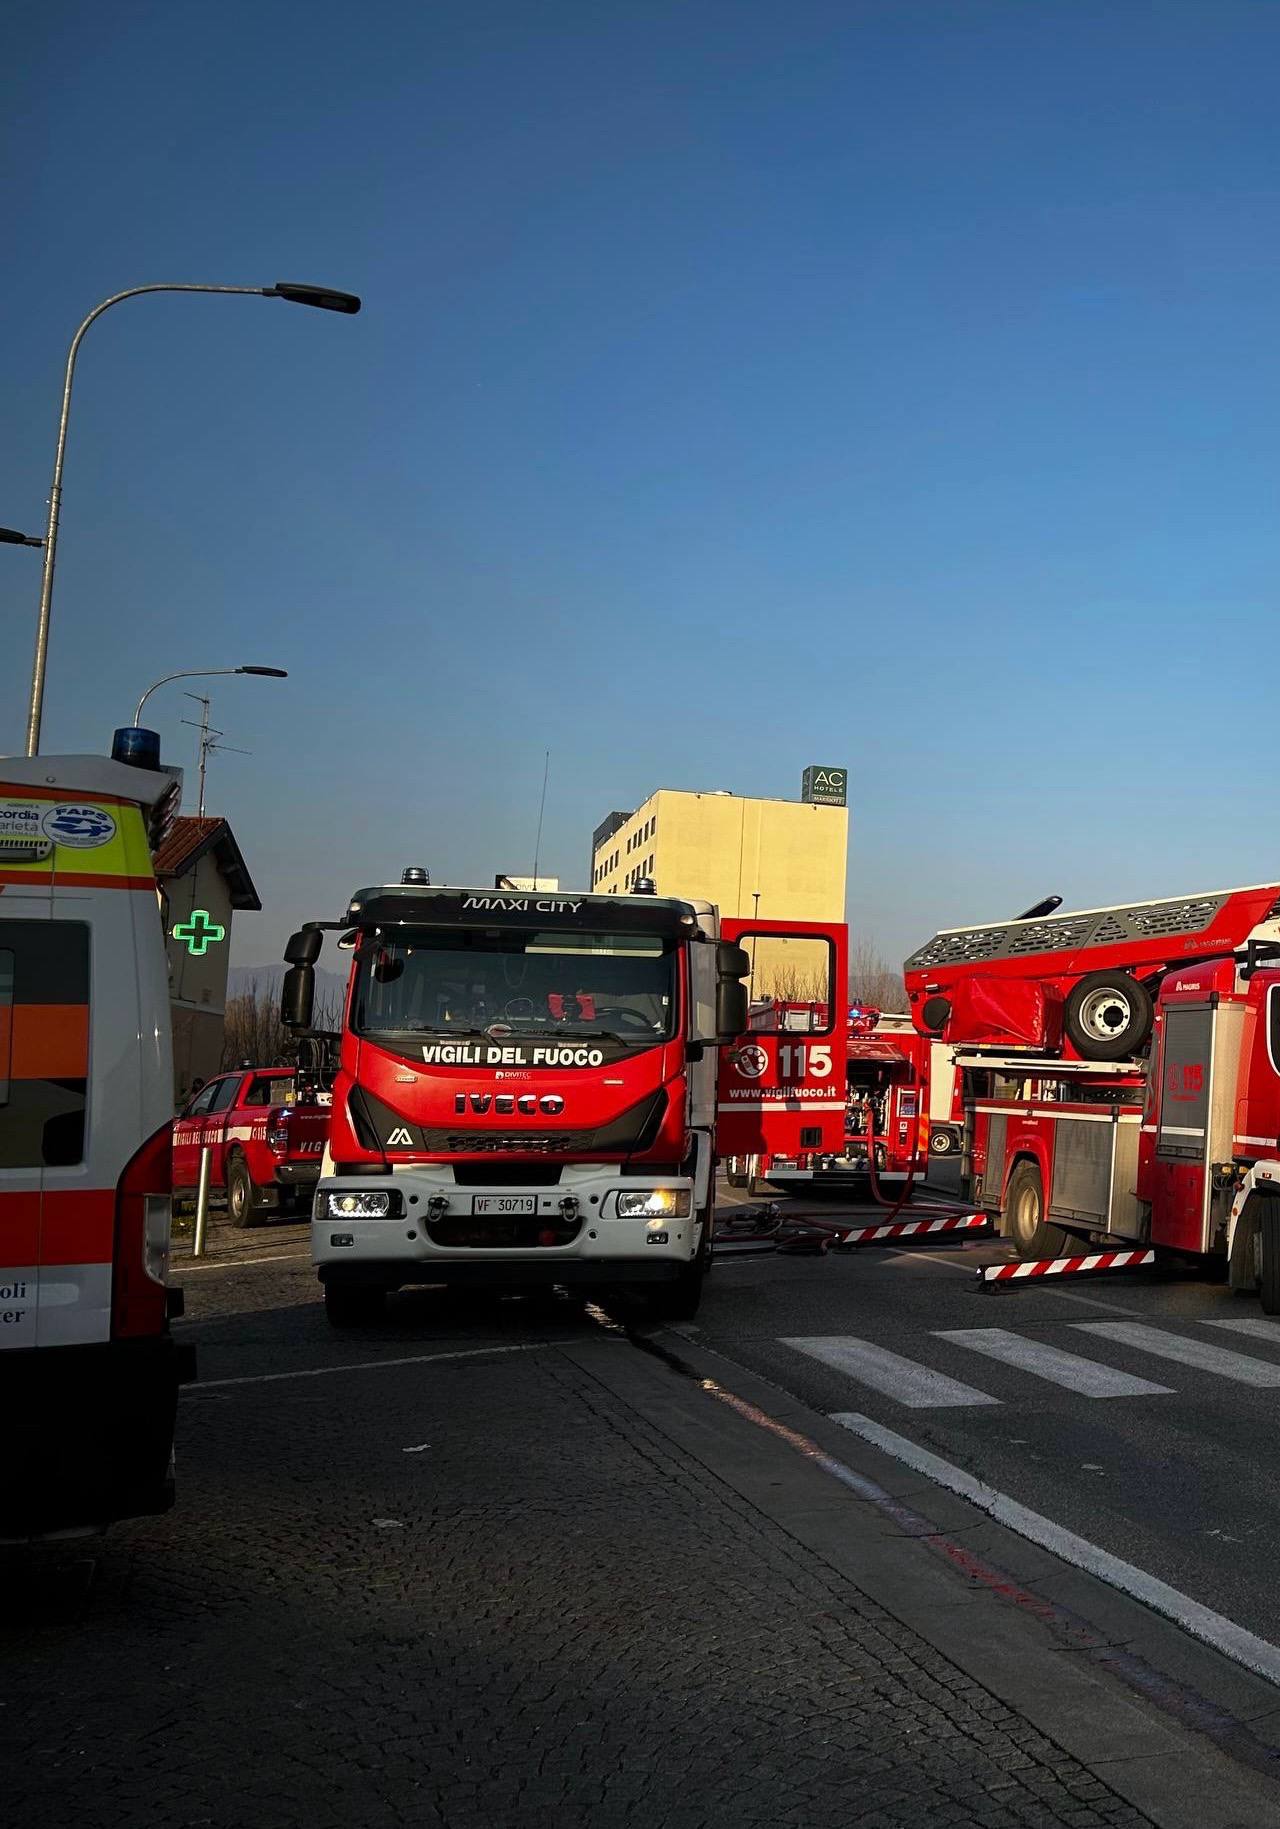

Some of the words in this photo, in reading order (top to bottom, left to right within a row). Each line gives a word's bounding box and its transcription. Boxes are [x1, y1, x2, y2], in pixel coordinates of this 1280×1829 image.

[815, 771, 844, 787] AC
[55, 808, 108, 821] FAPS
[462, 897, 528, 911] MAXI
[535, 900, 583, 913] CITY
[422, 1045, 481, 1064] VIGILI
[486, 1047, 526, 1065] DEL
[532, 1048, 604, 1067] FUOCO
[779, 1045, 833, 1078] 115
[729, 1086, 836, 1100] www.vigilfuoco.it
[454, 1093, 566, 1116] IVECO
[478, 1199, 492, 1212] VF
[498, 1199, 533, 1211] 30719
